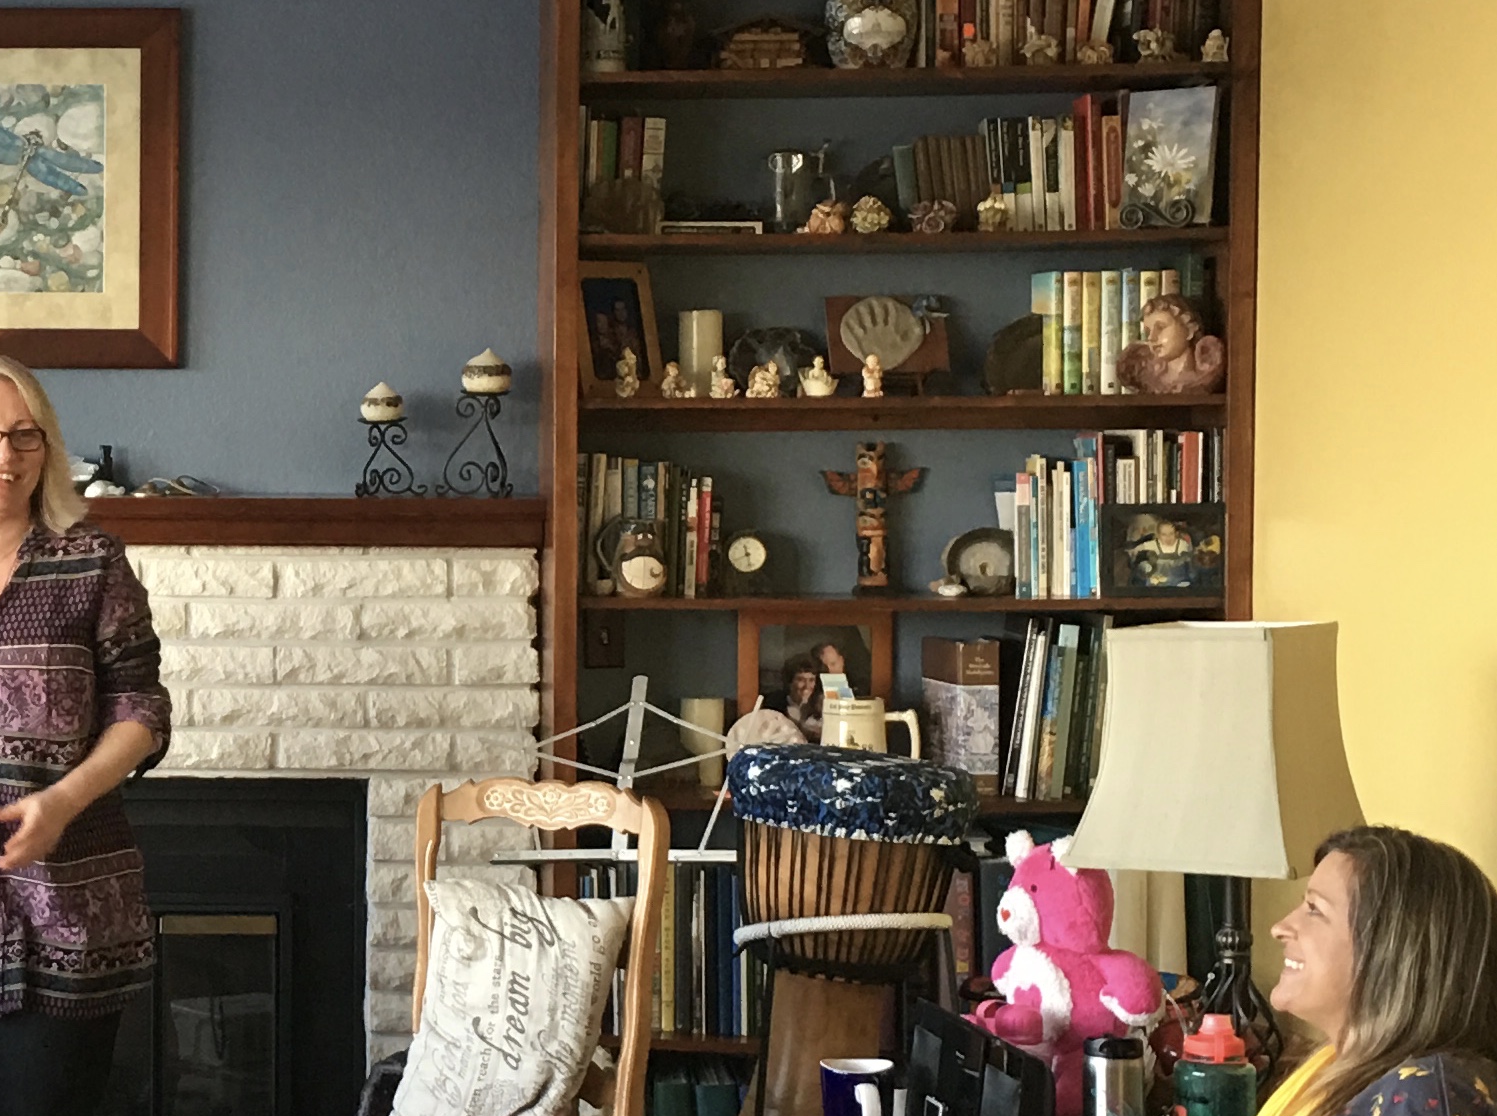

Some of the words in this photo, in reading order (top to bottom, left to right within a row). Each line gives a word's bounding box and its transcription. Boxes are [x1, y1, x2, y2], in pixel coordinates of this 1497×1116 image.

[468, 898, 560, 951] big
[490, 953, 503, 989] stars
[590, 961, 603, 1006] world
[471, 968, 532, 1071] dream
[488, 991, 501, 1015] the
[482, 1021, 496, 1042] for
[476, 1046, 494, 1082] reach
